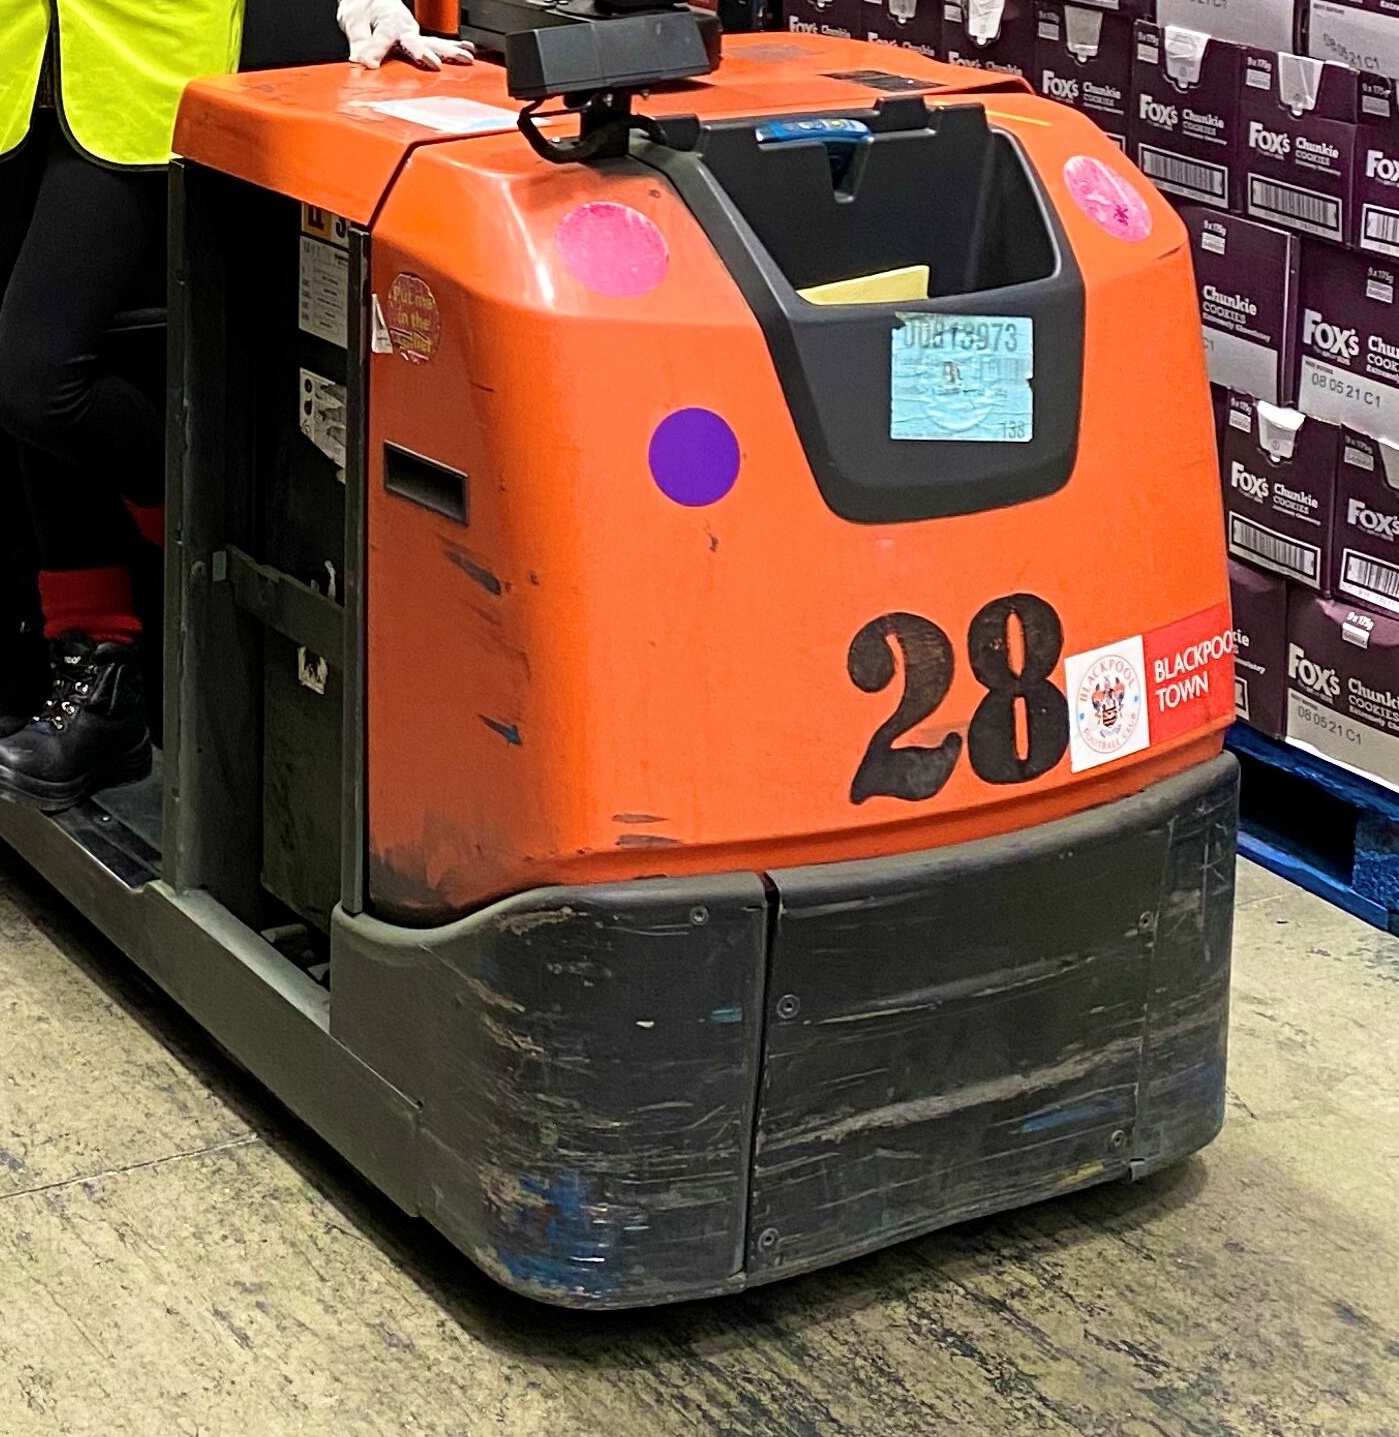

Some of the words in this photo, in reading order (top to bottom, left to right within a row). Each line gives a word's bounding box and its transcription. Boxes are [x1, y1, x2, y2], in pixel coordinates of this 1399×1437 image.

[1312, 373, 1327, 388] 08
[1330, 379, 1344, 392] 05
[1346, 384, 1361, 400] 21
[1364, 392, 1381, 407] C1
[1154, 631, 1234, 684] BLACKPOO
[846, 592, 1071, 805] 28
[1155, 675, 1209, 712] TOWN
